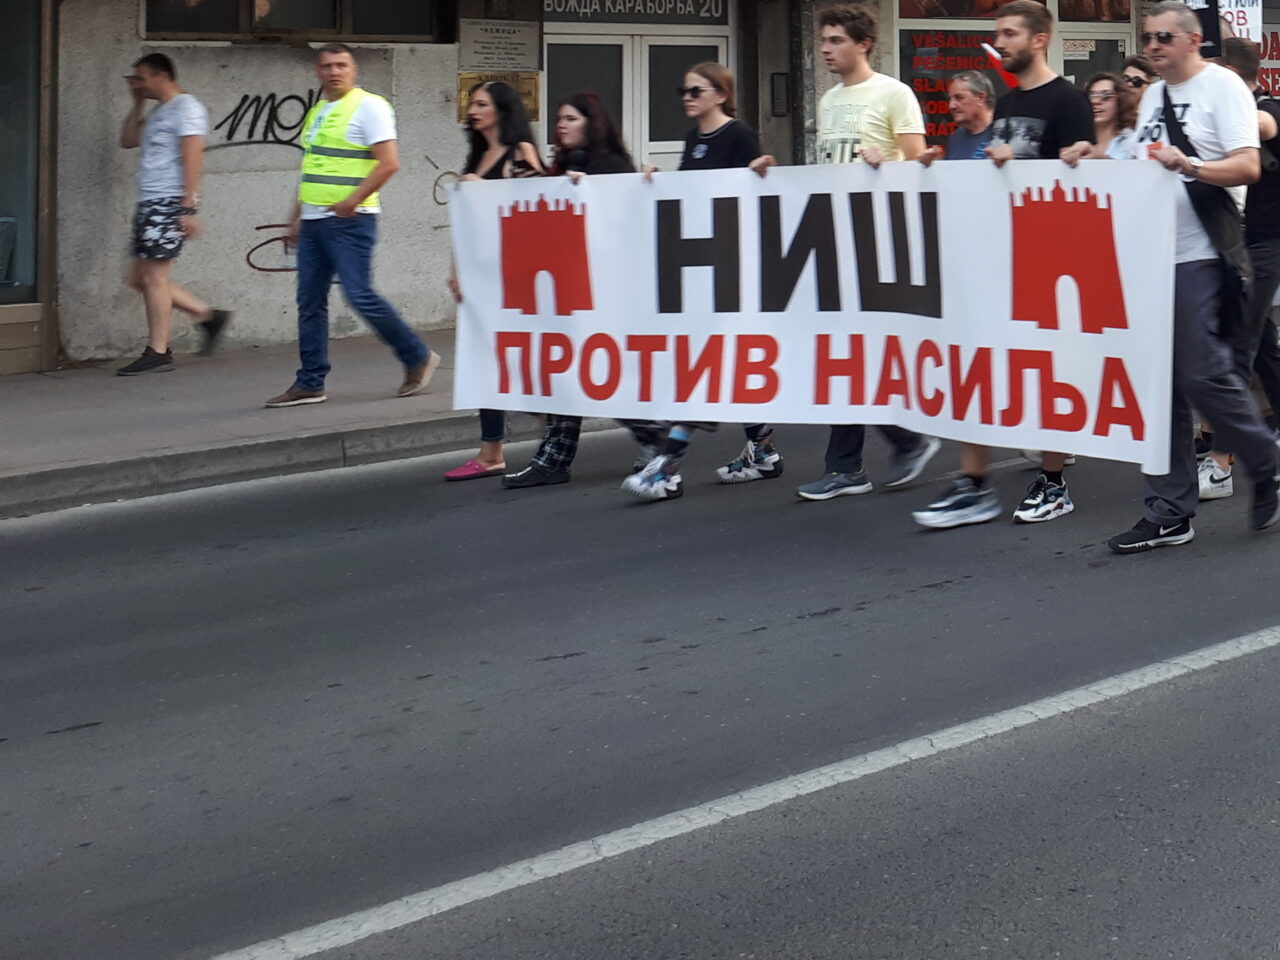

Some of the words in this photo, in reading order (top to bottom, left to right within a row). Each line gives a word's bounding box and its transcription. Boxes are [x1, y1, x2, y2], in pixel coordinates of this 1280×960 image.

[656, 191, 943, 319] НИШ
[494, 331, 780, 404] ПРОТИВ
[813, 333, 1146, 441] НАСИЉА
